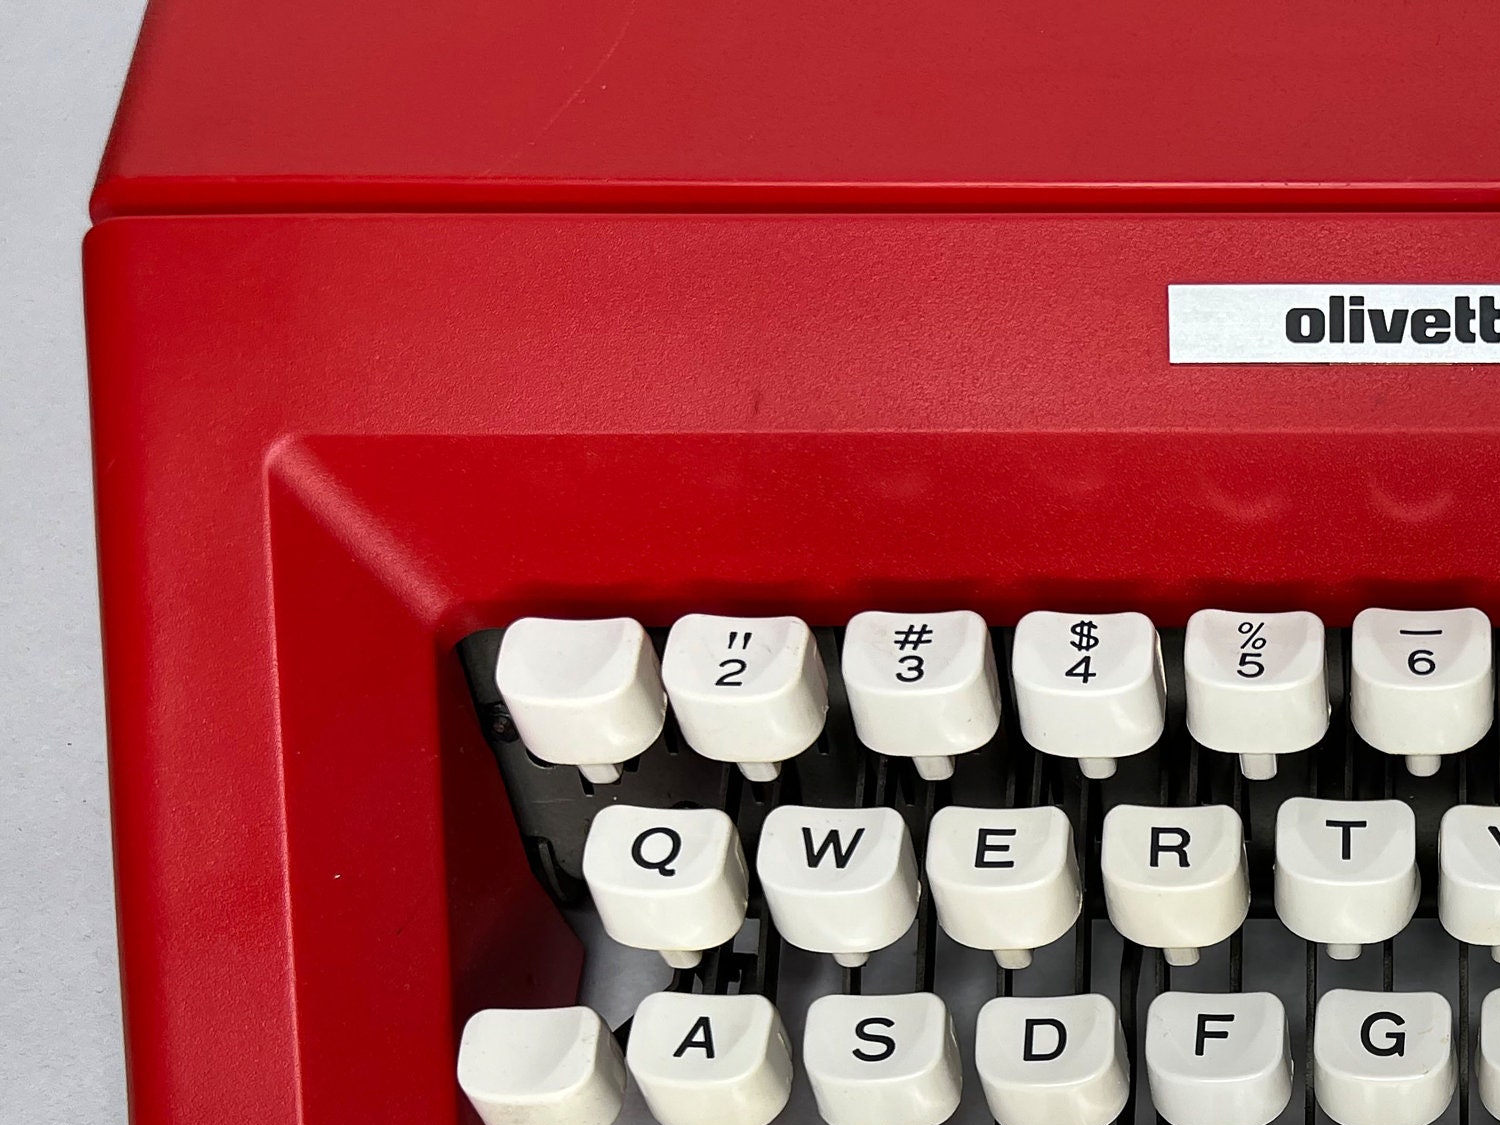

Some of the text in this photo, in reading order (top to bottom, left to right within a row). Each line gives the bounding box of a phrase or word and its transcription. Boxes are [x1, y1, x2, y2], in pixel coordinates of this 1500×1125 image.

[893, 623, 934, 651] #
[1069, 620, 1100, 652] $
[1237, 621, 1267, 650] %
[714, 658, 747, 687] 2
[895, 655, 925, 683] 3
[1064, 655, 1097, 684] 4
[1236, 652, 1265, 679] 5
[1407, 649, 1436, 676] 6
[631, 826, 682, 877] Q
[801, 826, 866, 869] W
[974, 827, 1017, 869] E
[1149, 826, 1191, 868] R
[1325, 819, 1368, 861] T
[672, 1016, 715, 1059] A
[852, 1017, 896, 1062] S
[1022, 1018, 1068, 1062] D
[1194, 1013, 1235, 1057] F
[1360, 1011, 1406, 1058] G
